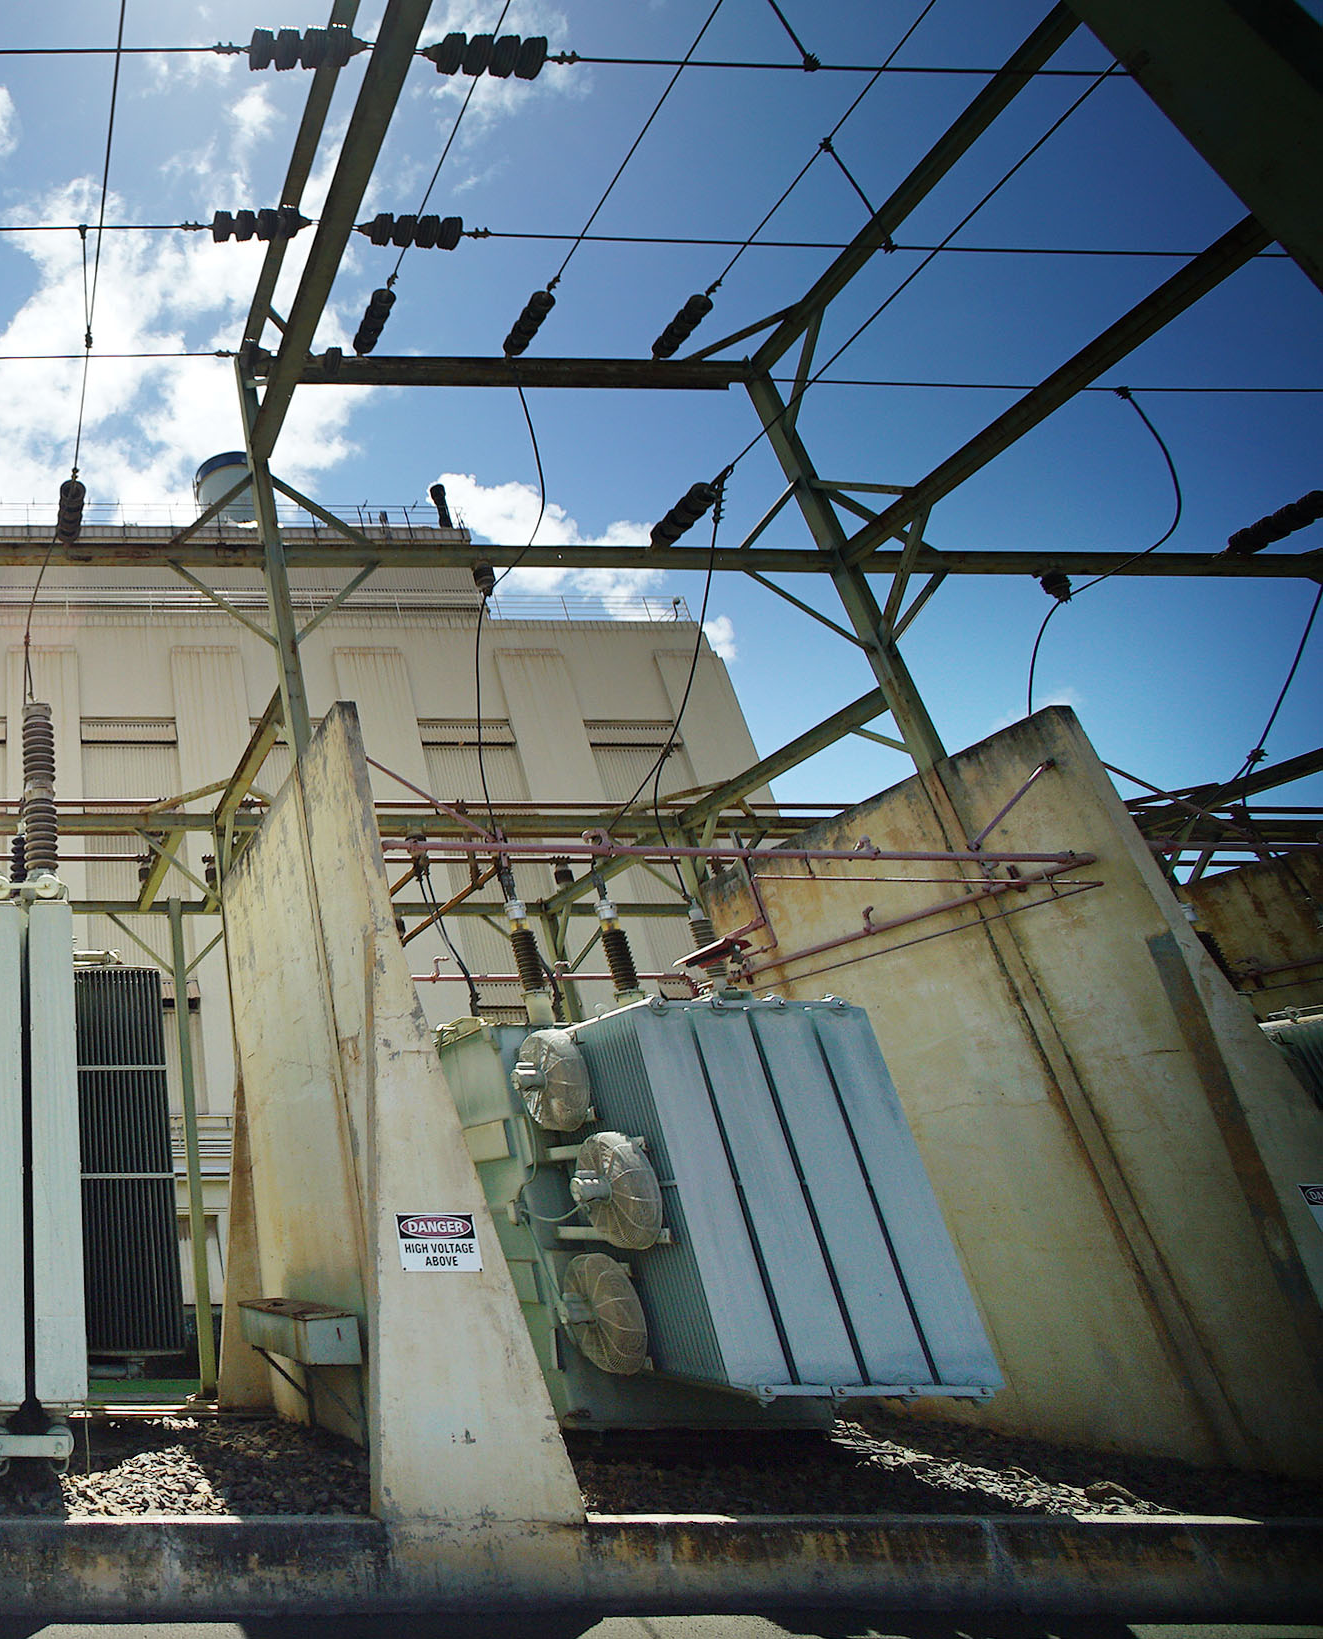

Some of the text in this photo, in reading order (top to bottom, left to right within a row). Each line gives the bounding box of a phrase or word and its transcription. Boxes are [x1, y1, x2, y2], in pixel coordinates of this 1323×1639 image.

[407, 1221, 464, 1233] DANGER
[404, 1243, 475, 1254] HIGH VOLTAGE
[425, 1256, 459, 1266] ABOVE
